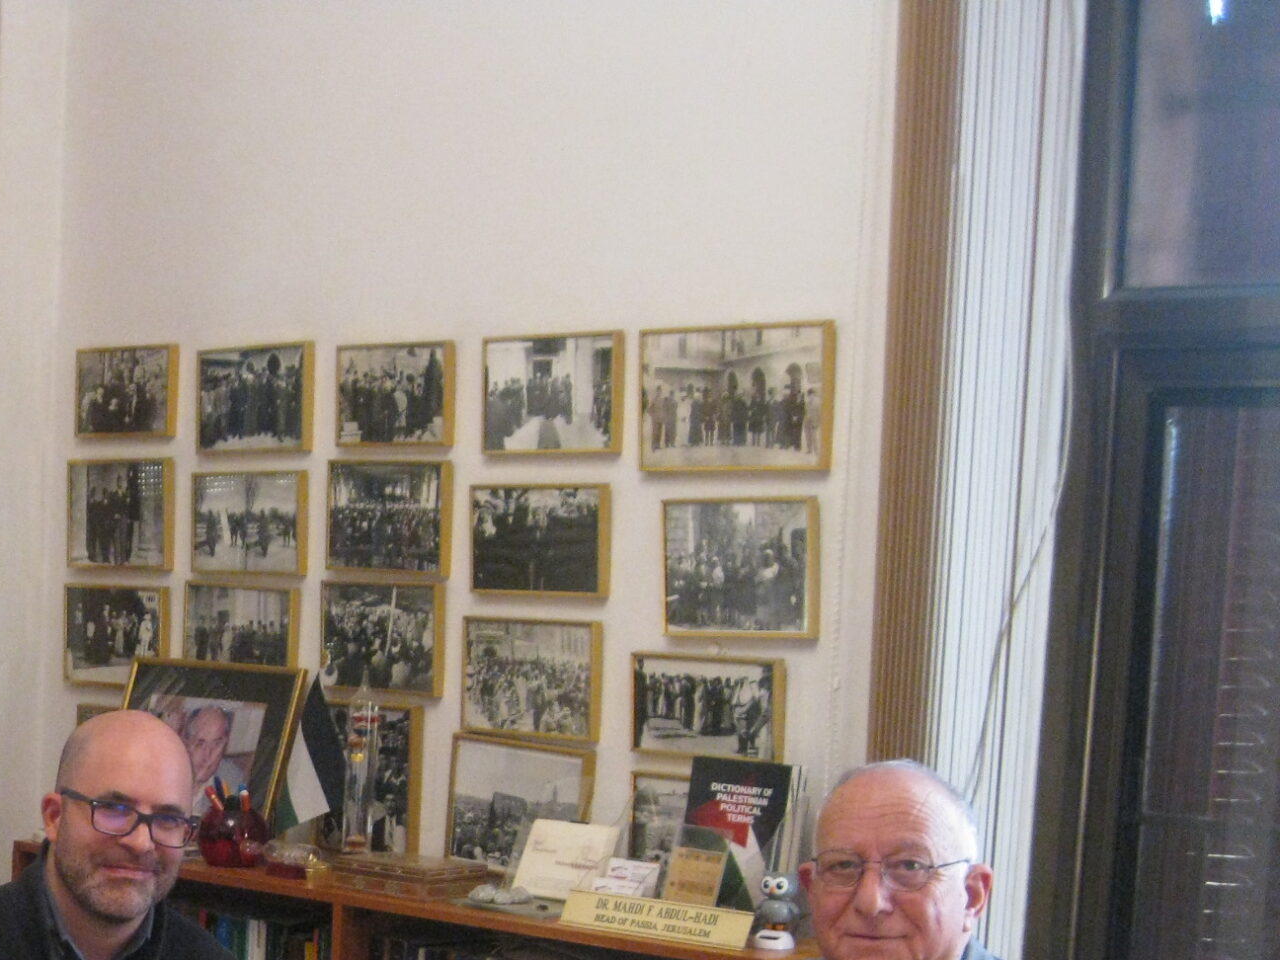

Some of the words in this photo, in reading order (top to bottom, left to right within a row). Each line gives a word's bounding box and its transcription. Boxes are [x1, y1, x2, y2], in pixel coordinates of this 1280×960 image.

[710, 782, 762, 795] DICTIONARY
[762, 788, 774, 796] OF
[716, 793, 769, 806] PALESTINIAN
[720, 803, 762, 816] POLITICAL
[726, 814, 754, 823] TERMS
[612, 900, 645, 915] MAHDI
[656, 906, 720, 926] ABDUL-HADI
[594, 913, 616, 924] HEAD
[617, 917, 629, 925] OF
[629, 918, 658, 931] PASSIA,
[660, 923, 711, 938] JERUSALEM
